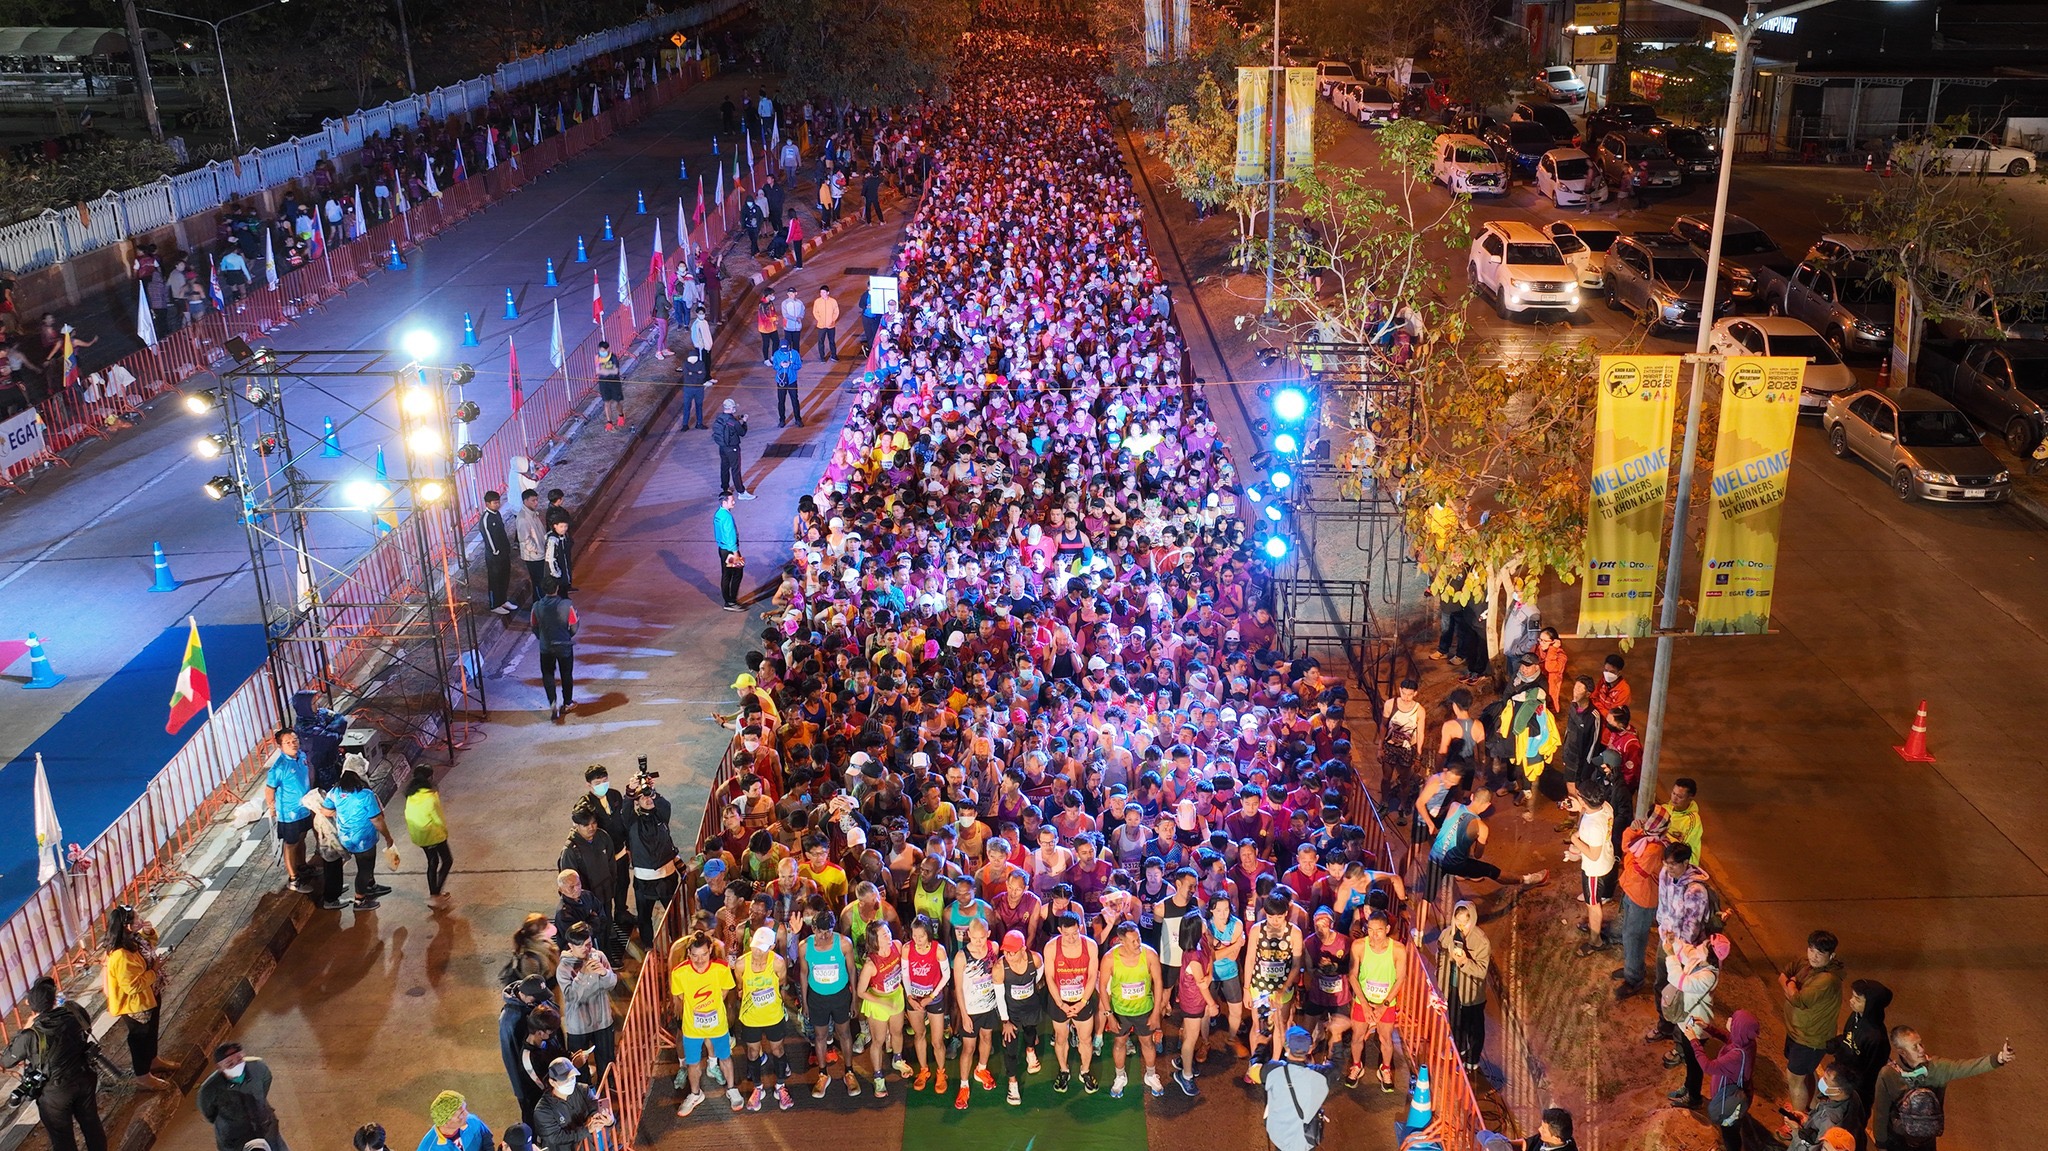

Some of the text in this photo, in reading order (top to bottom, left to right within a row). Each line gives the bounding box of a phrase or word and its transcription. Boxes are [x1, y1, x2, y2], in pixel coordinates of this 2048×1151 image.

[1767, 381, 1797, 390] 2023
[8, 420, 39, 451] EGAT
[1591, 447, 1669, 496] WELCOME
[1712, 449, 1789, 496] WELCOME
[1597, 479, 1652, 508] ALL RUNNERS
[1601, 485, 1665, 519] TO KHON KAEN!
[1718, 480, 1774, 509] ALL RUNNERS
[1722, 509, 1733, 520] TO
[1733, 499, 1759, 515] KHON
[1599, 561, 1617, 569] ptt
[1718, 560, 1735, 569] ptt
